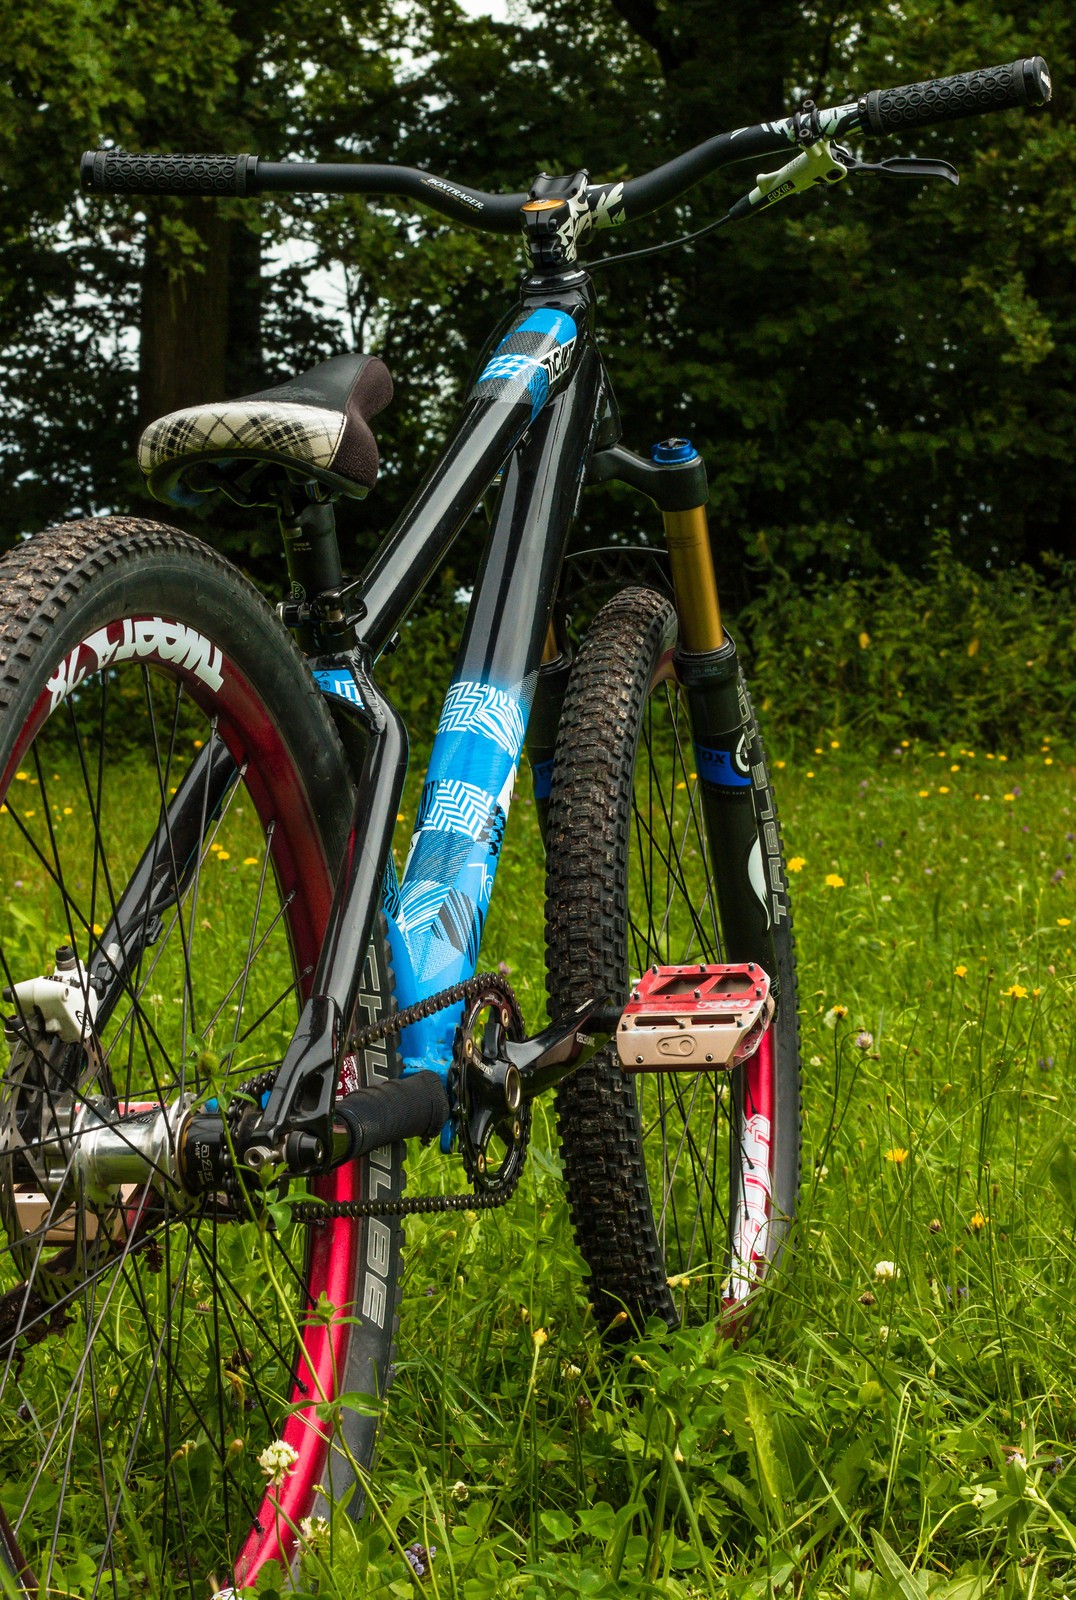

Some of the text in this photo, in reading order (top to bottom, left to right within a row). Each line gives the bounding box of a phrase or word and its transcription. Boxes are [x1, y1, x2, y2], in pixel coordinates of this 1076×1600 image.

[427, 178, 483, 210] BONTRAGER
[750, 761, 788, 925] TABLE
[359, 940, 392, 1329] CHLBE
